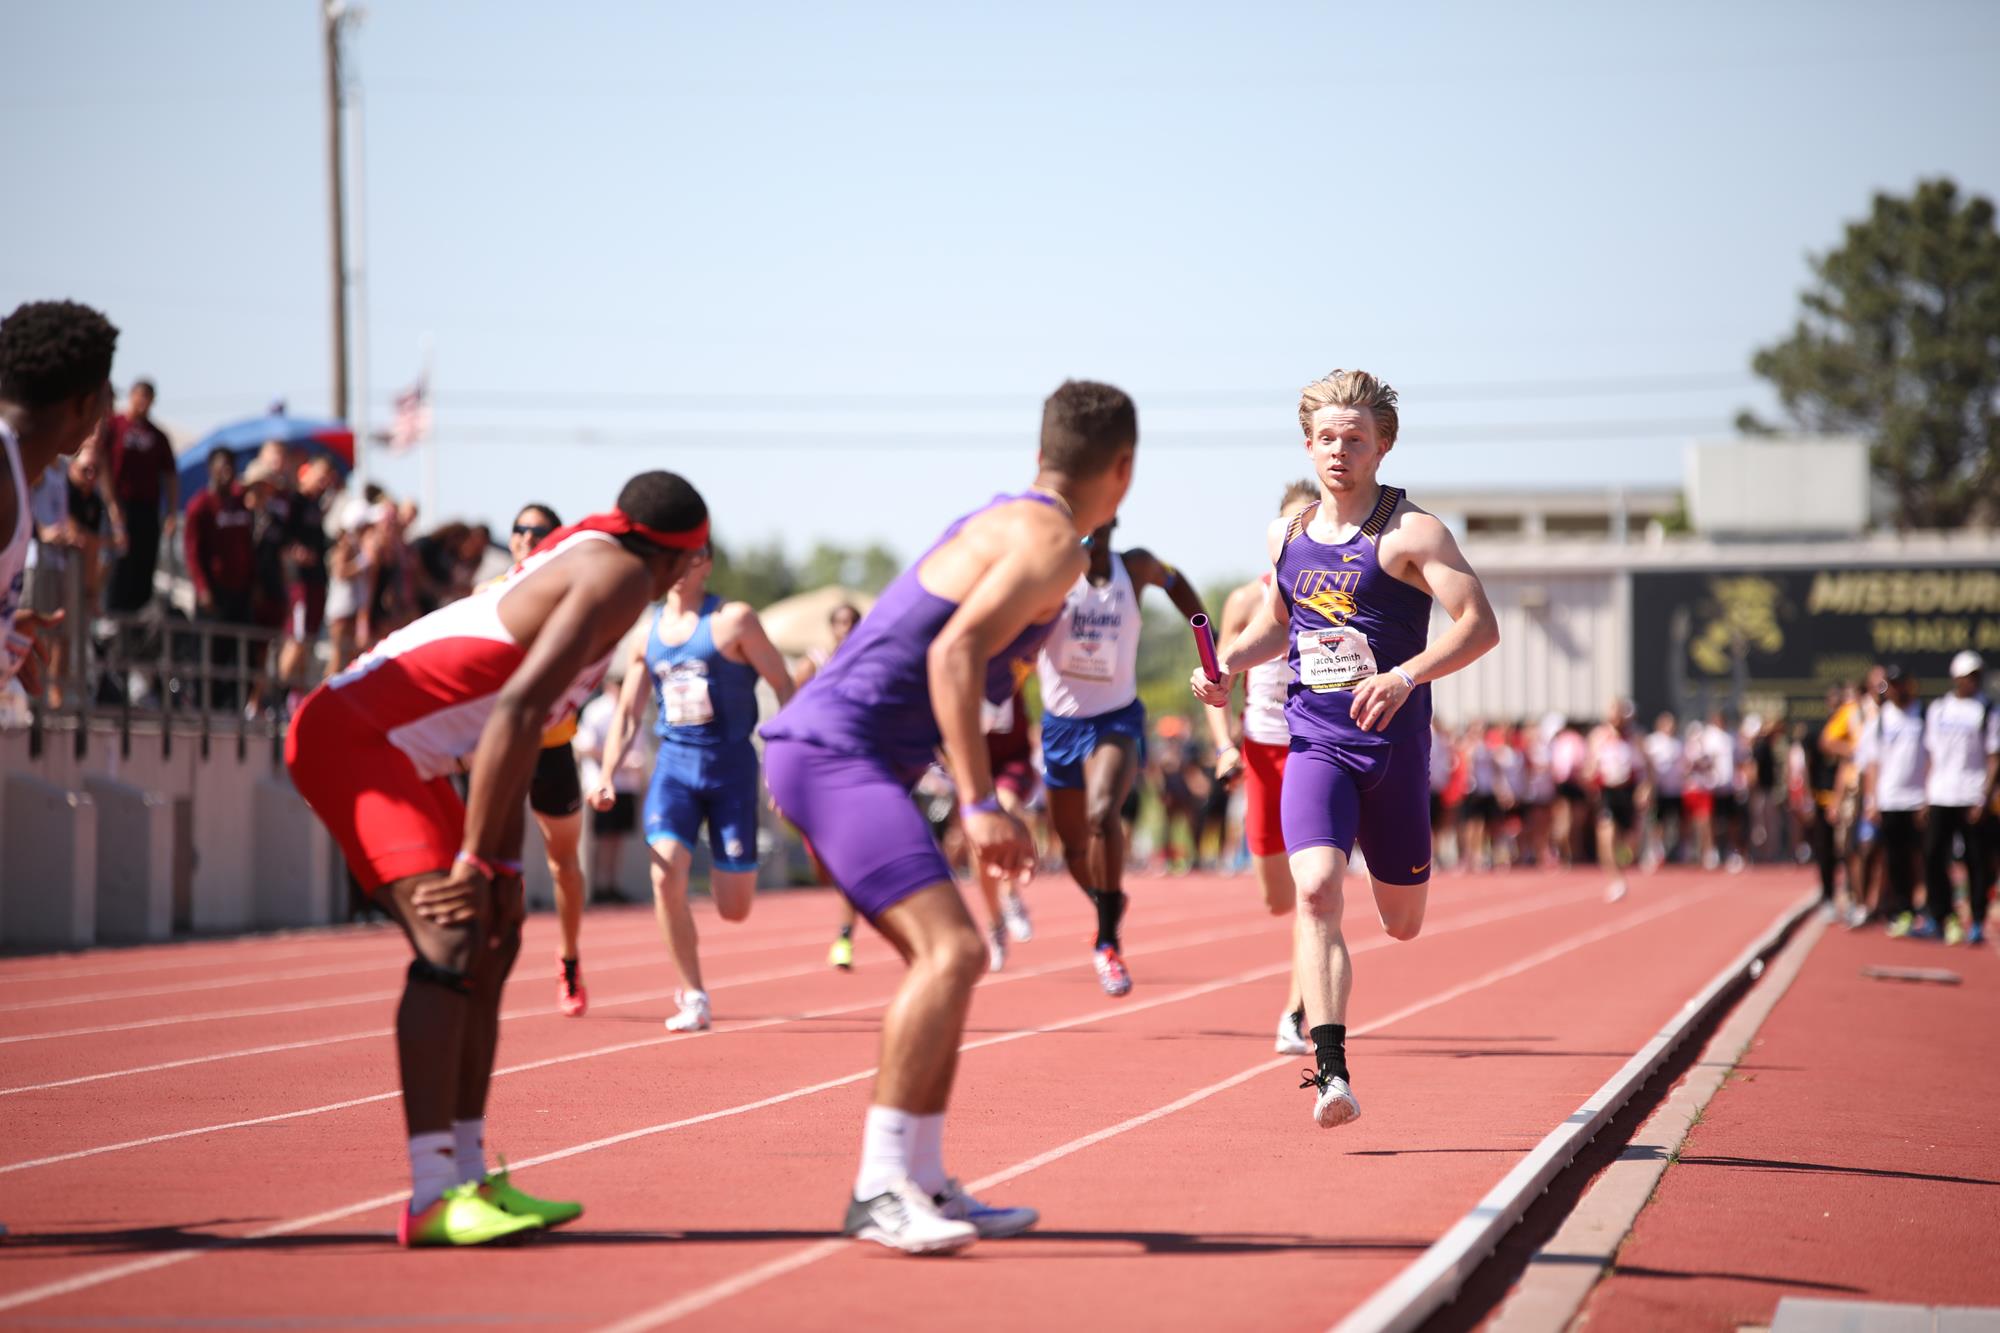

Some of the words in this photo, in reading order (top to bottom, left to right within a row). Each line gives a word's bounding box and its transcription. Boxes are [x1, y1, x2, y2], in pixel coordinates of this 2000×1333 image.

[1293, 570, 1361, 601] UNI
[1335, 652, 1361, 663] Smith
[1310, 667, 1347, 676] Northern
[1348, 664, 1369, 673] Iowa
